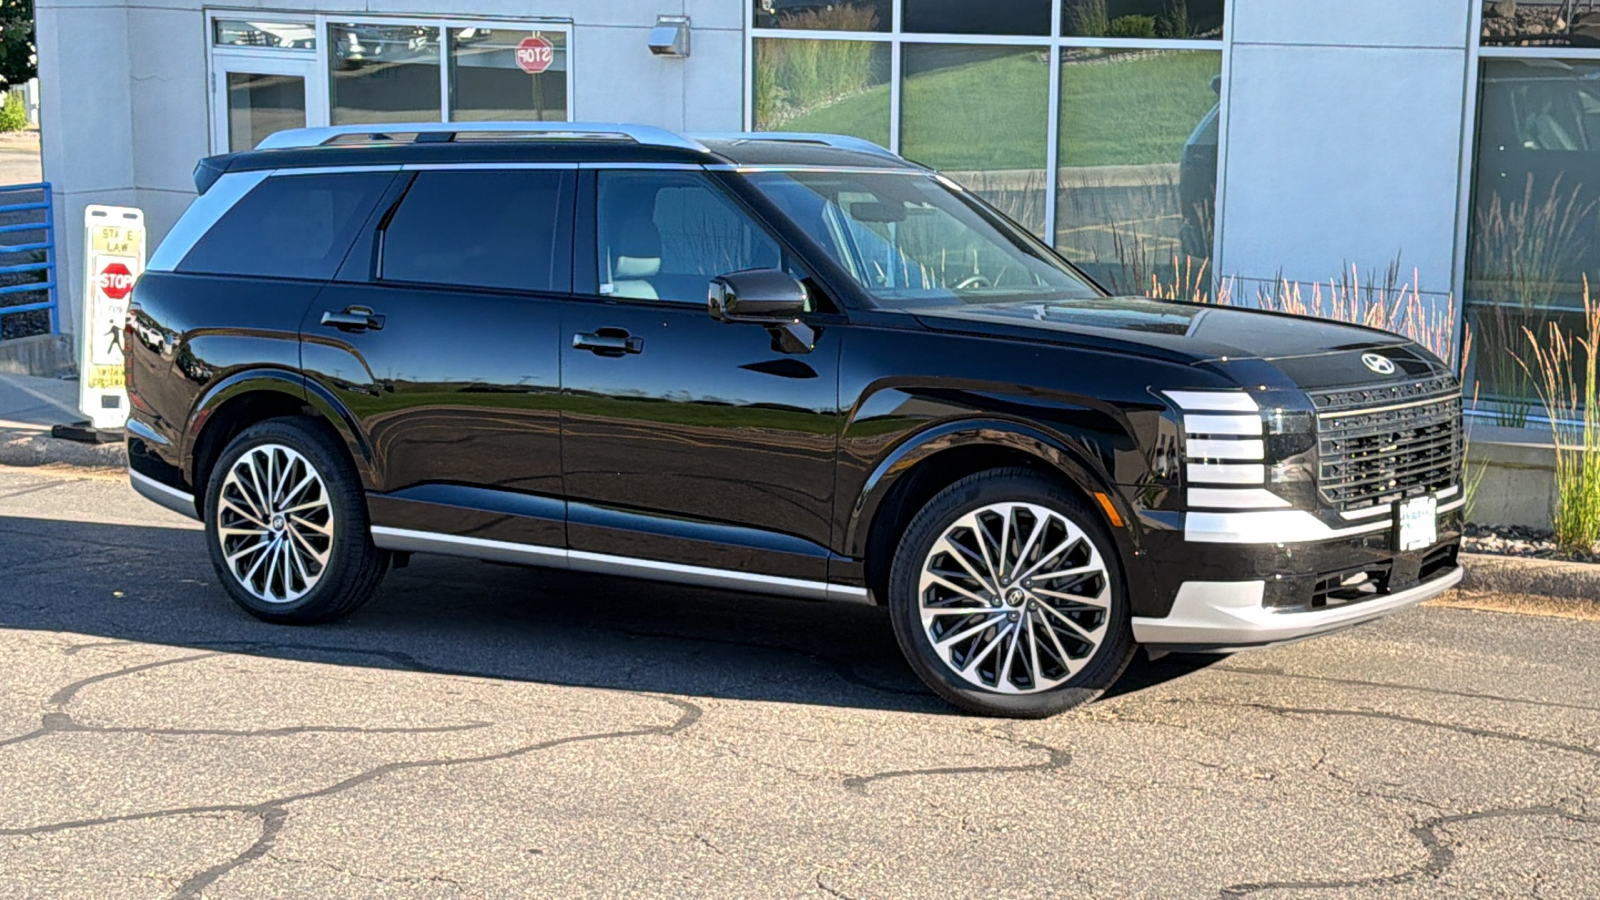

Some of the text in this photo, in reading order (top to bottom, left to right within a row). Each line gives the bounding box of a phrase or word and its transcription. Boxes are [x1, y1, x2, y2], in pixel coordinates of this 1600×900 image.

[102, 228, 133, 241] STAE
[107, 242, 128, 253] LAW
[100, 273, 133, 289] STOP
